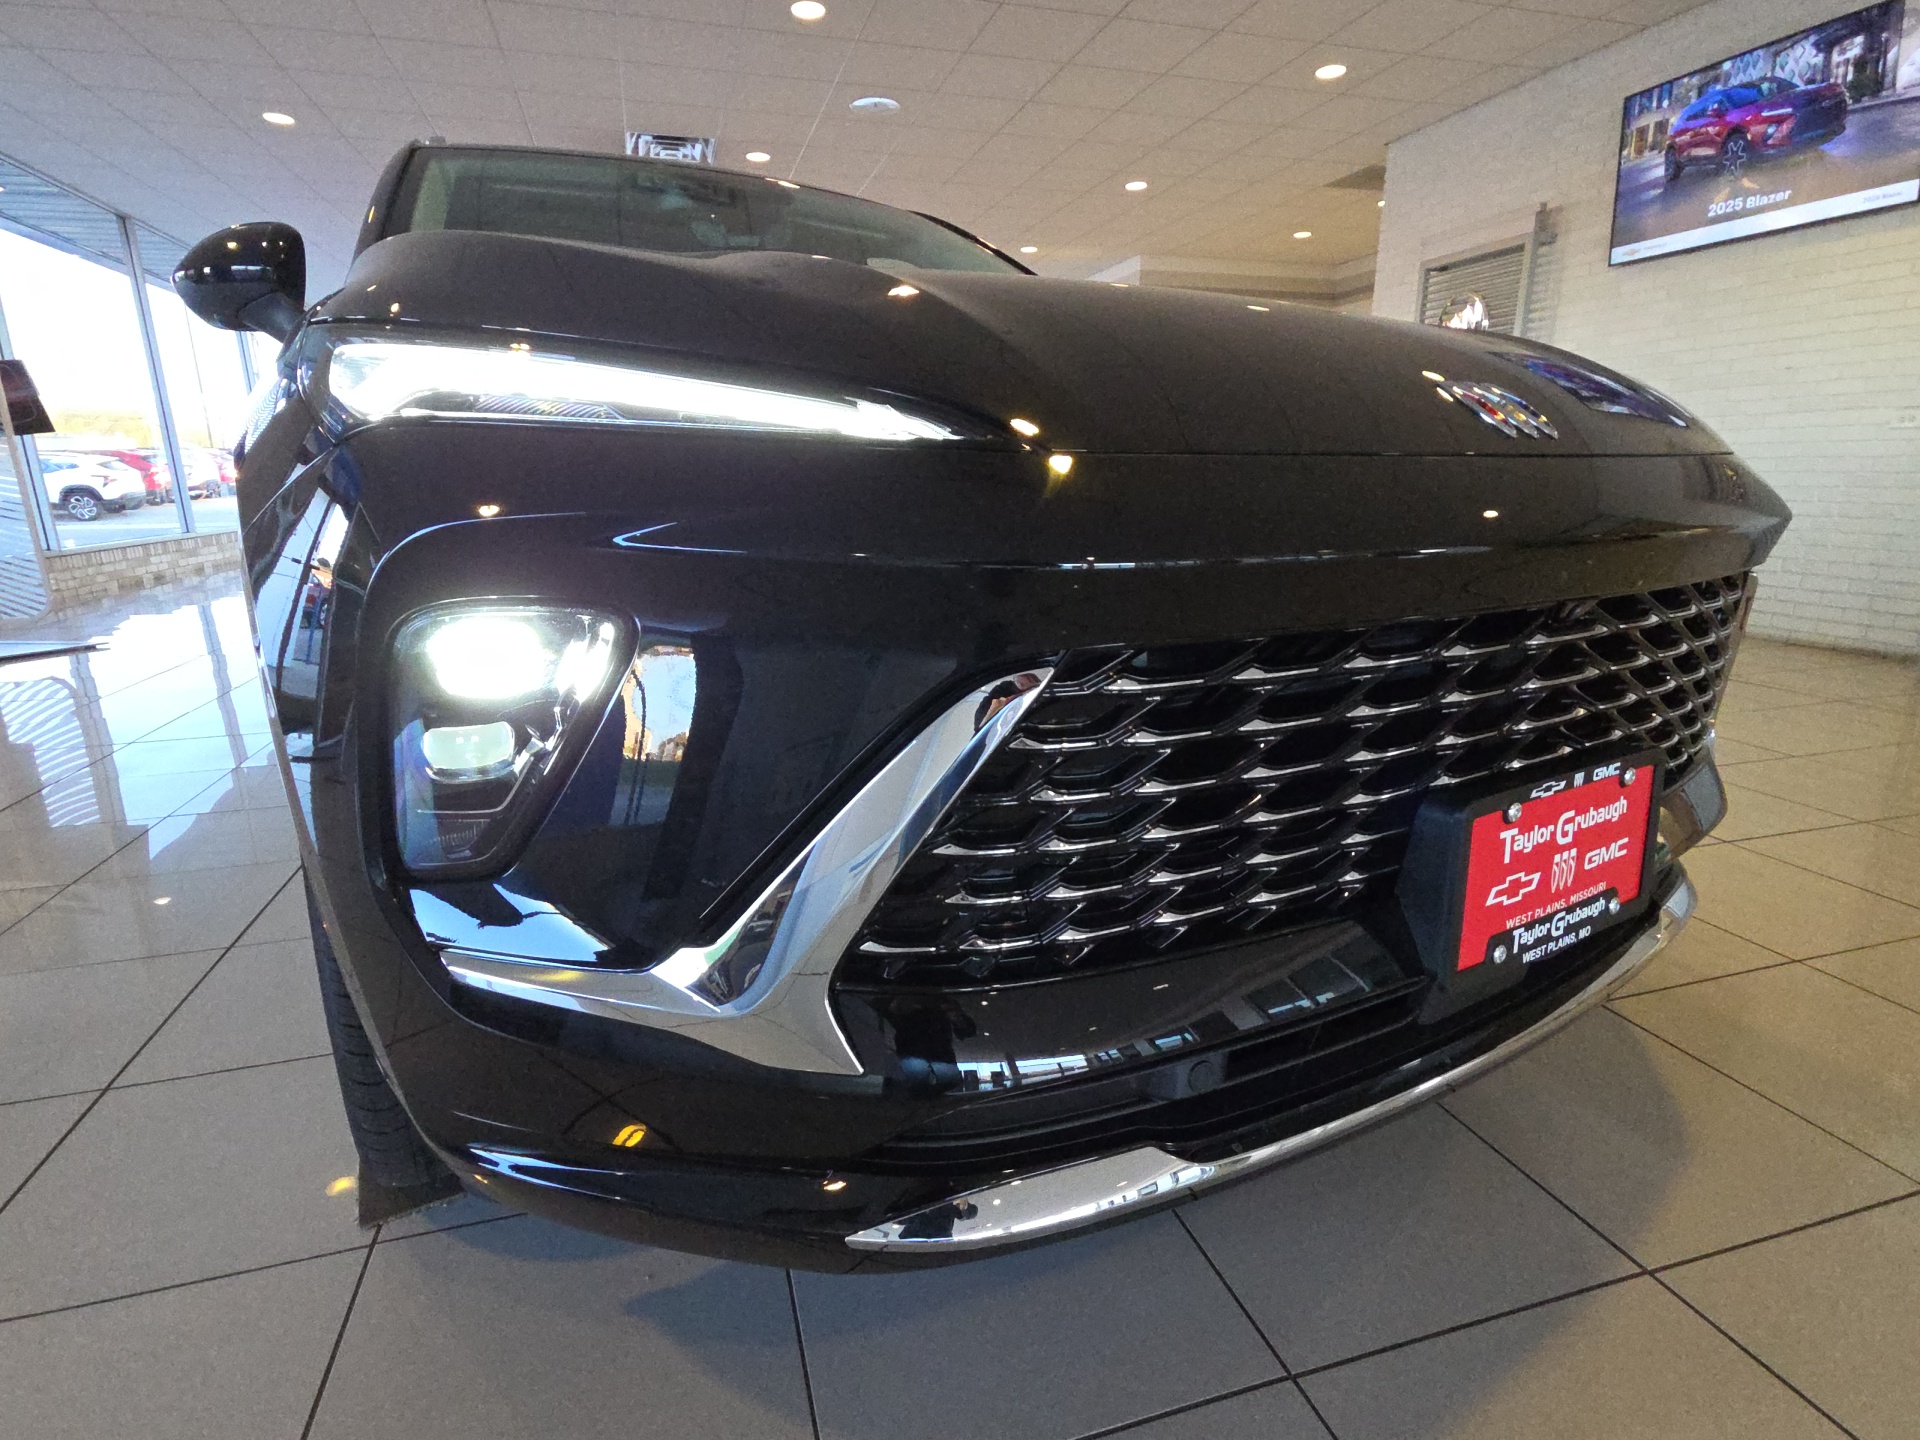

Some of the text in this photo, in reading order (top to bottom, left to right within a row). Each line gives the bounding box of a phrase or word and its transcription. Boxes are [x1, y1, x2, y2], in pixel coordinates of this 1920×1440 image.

[1707, 189, 1792, 217] 2025 Blazer
[1592, 762, 1621, 781] GMC
[1499, 796, 1627, 864] Taylor Grubaugh
[1583, 837, 1629, 870] GMC
[1505, 911, 1533, 930] WEST
[1569, 881, 1607, 904] MISSOURI
[1512, 897, 1606, 954] Taylor Grubaugh
[1522, 925, 1592, 964] WEST PLAINS, MO
